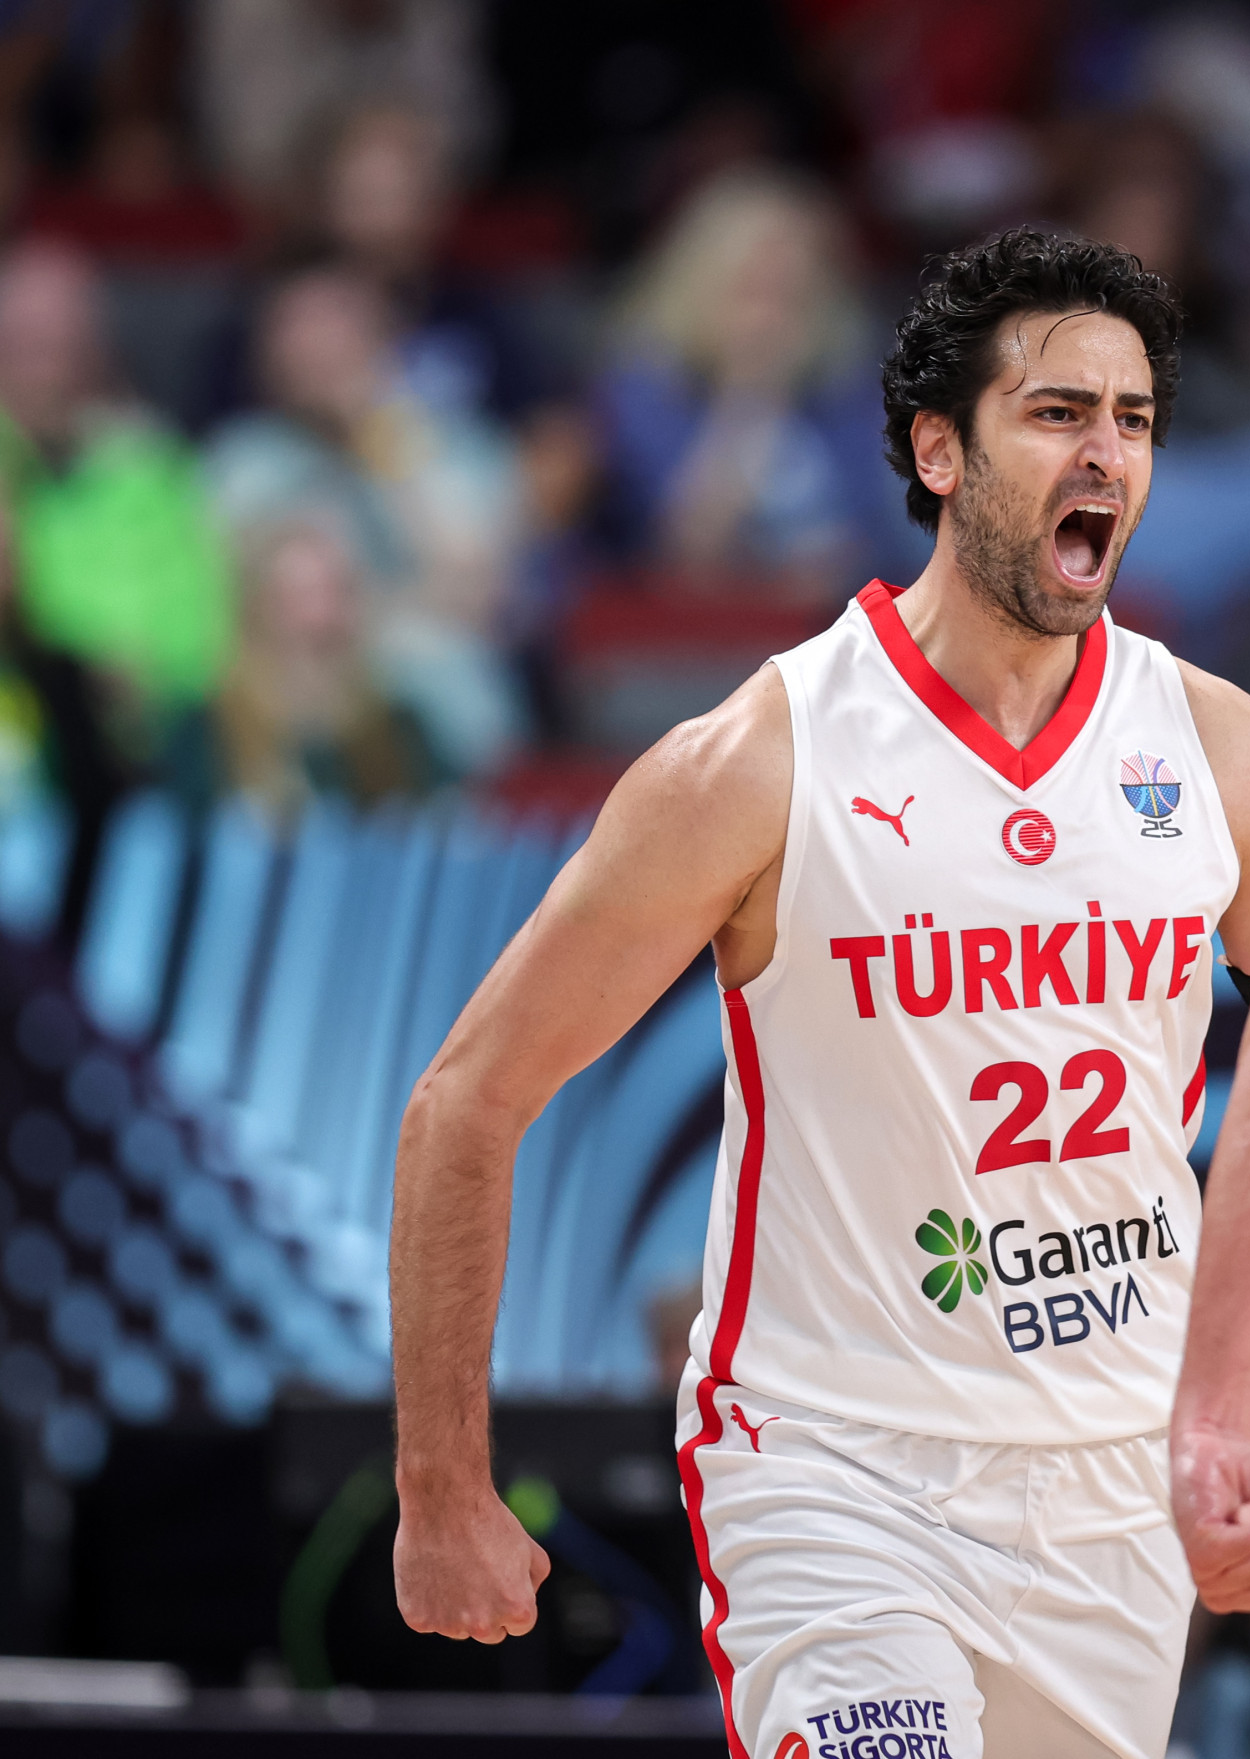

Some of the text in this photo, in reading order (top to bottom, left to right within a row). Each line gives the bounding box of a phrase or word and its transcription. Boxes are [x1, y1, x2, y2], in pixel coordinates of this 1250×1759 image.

[829, 900, 1206, 1019] TÜRKİYE
[969, 1048, 1131, 1176] 22
[988, 1195, 1180, 1286] Garanti
[1002, 1271, 1150, 1354] BBVA
